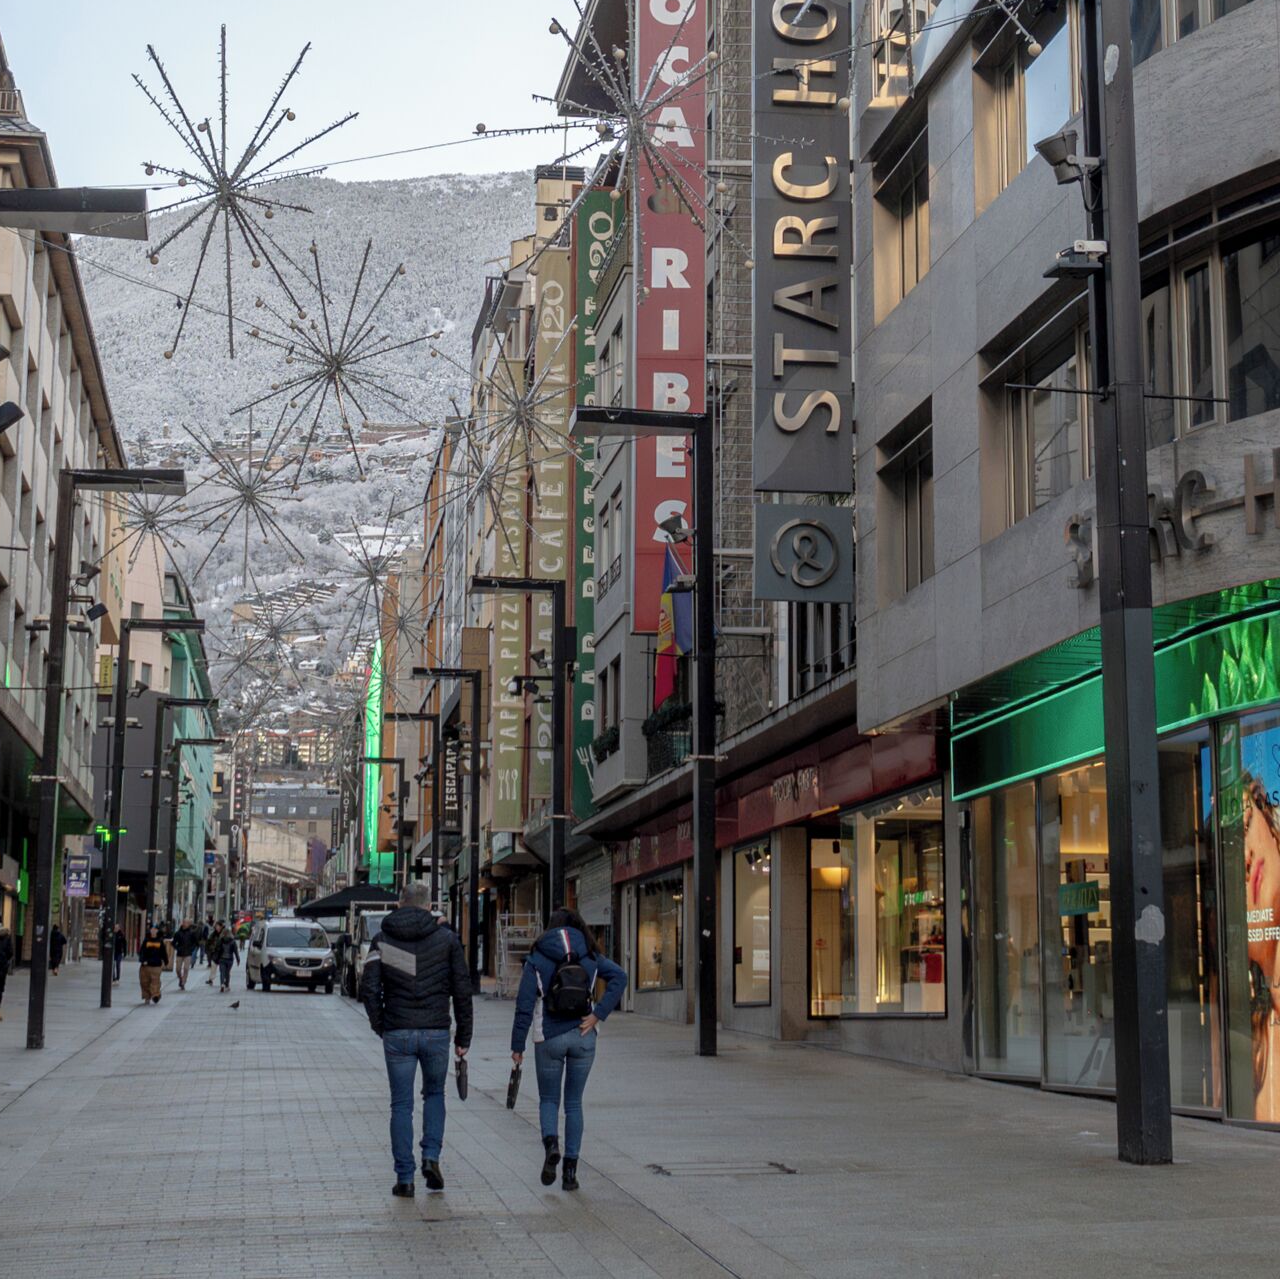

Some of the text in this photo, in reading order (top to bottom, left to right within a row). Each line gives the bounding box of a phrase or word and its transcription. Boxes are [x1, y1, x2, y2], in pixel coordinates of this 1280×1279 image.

[541, 280, 565, 344] 120
[772, 151, 841, 433] STARC
[651, 247, 691, 543] RIBES
[343, 790, 351, 829] HOTEL
